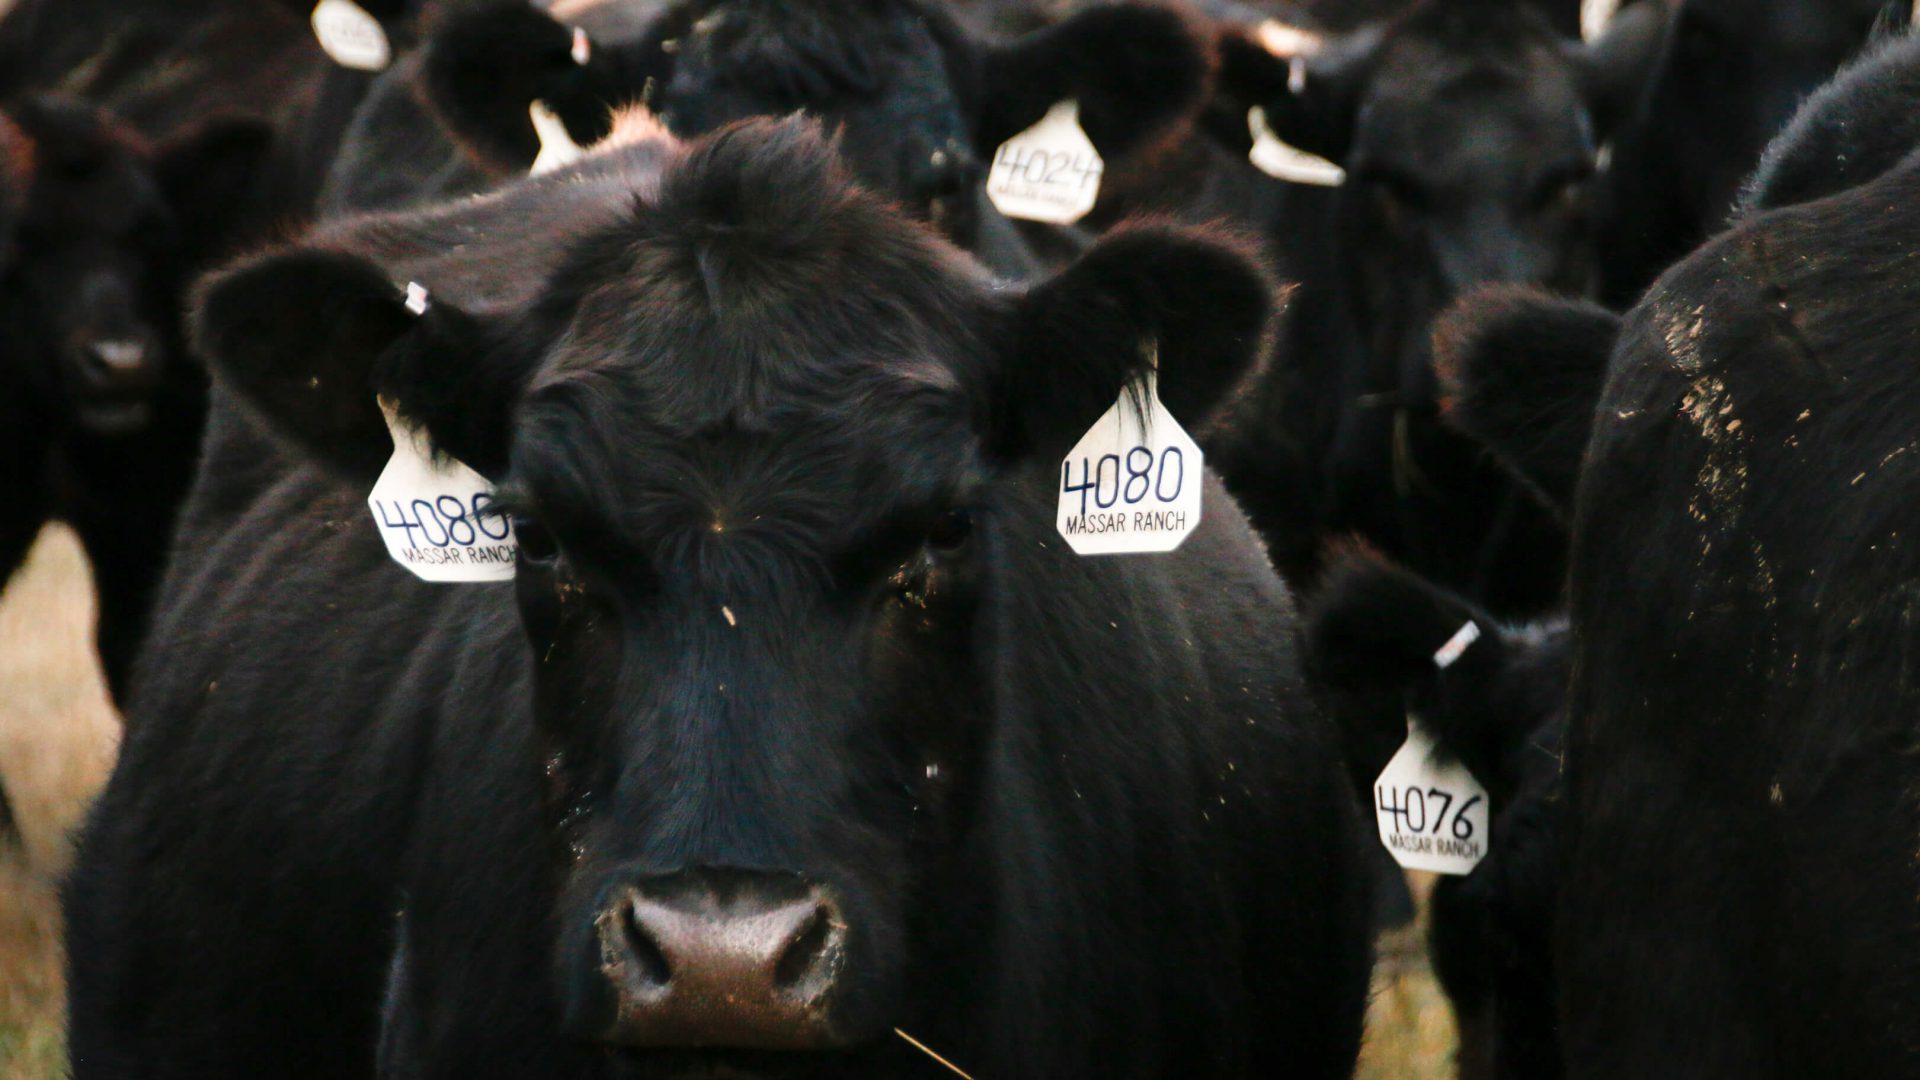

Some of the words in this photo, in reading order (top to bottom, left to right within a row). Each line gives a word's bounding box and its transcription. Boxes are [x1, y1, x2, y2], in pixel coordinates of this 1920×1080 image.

[998, 144, 1103, 190] 4024
[1063, 446, 1184, 515] 4080
[1065, 512, 1126, 535] MASSAR
[1133, 510, 1186, 532] RANCH
[402, 547, 465, 565] MASSAR
[1379, 785, 1482, 841] 4076
